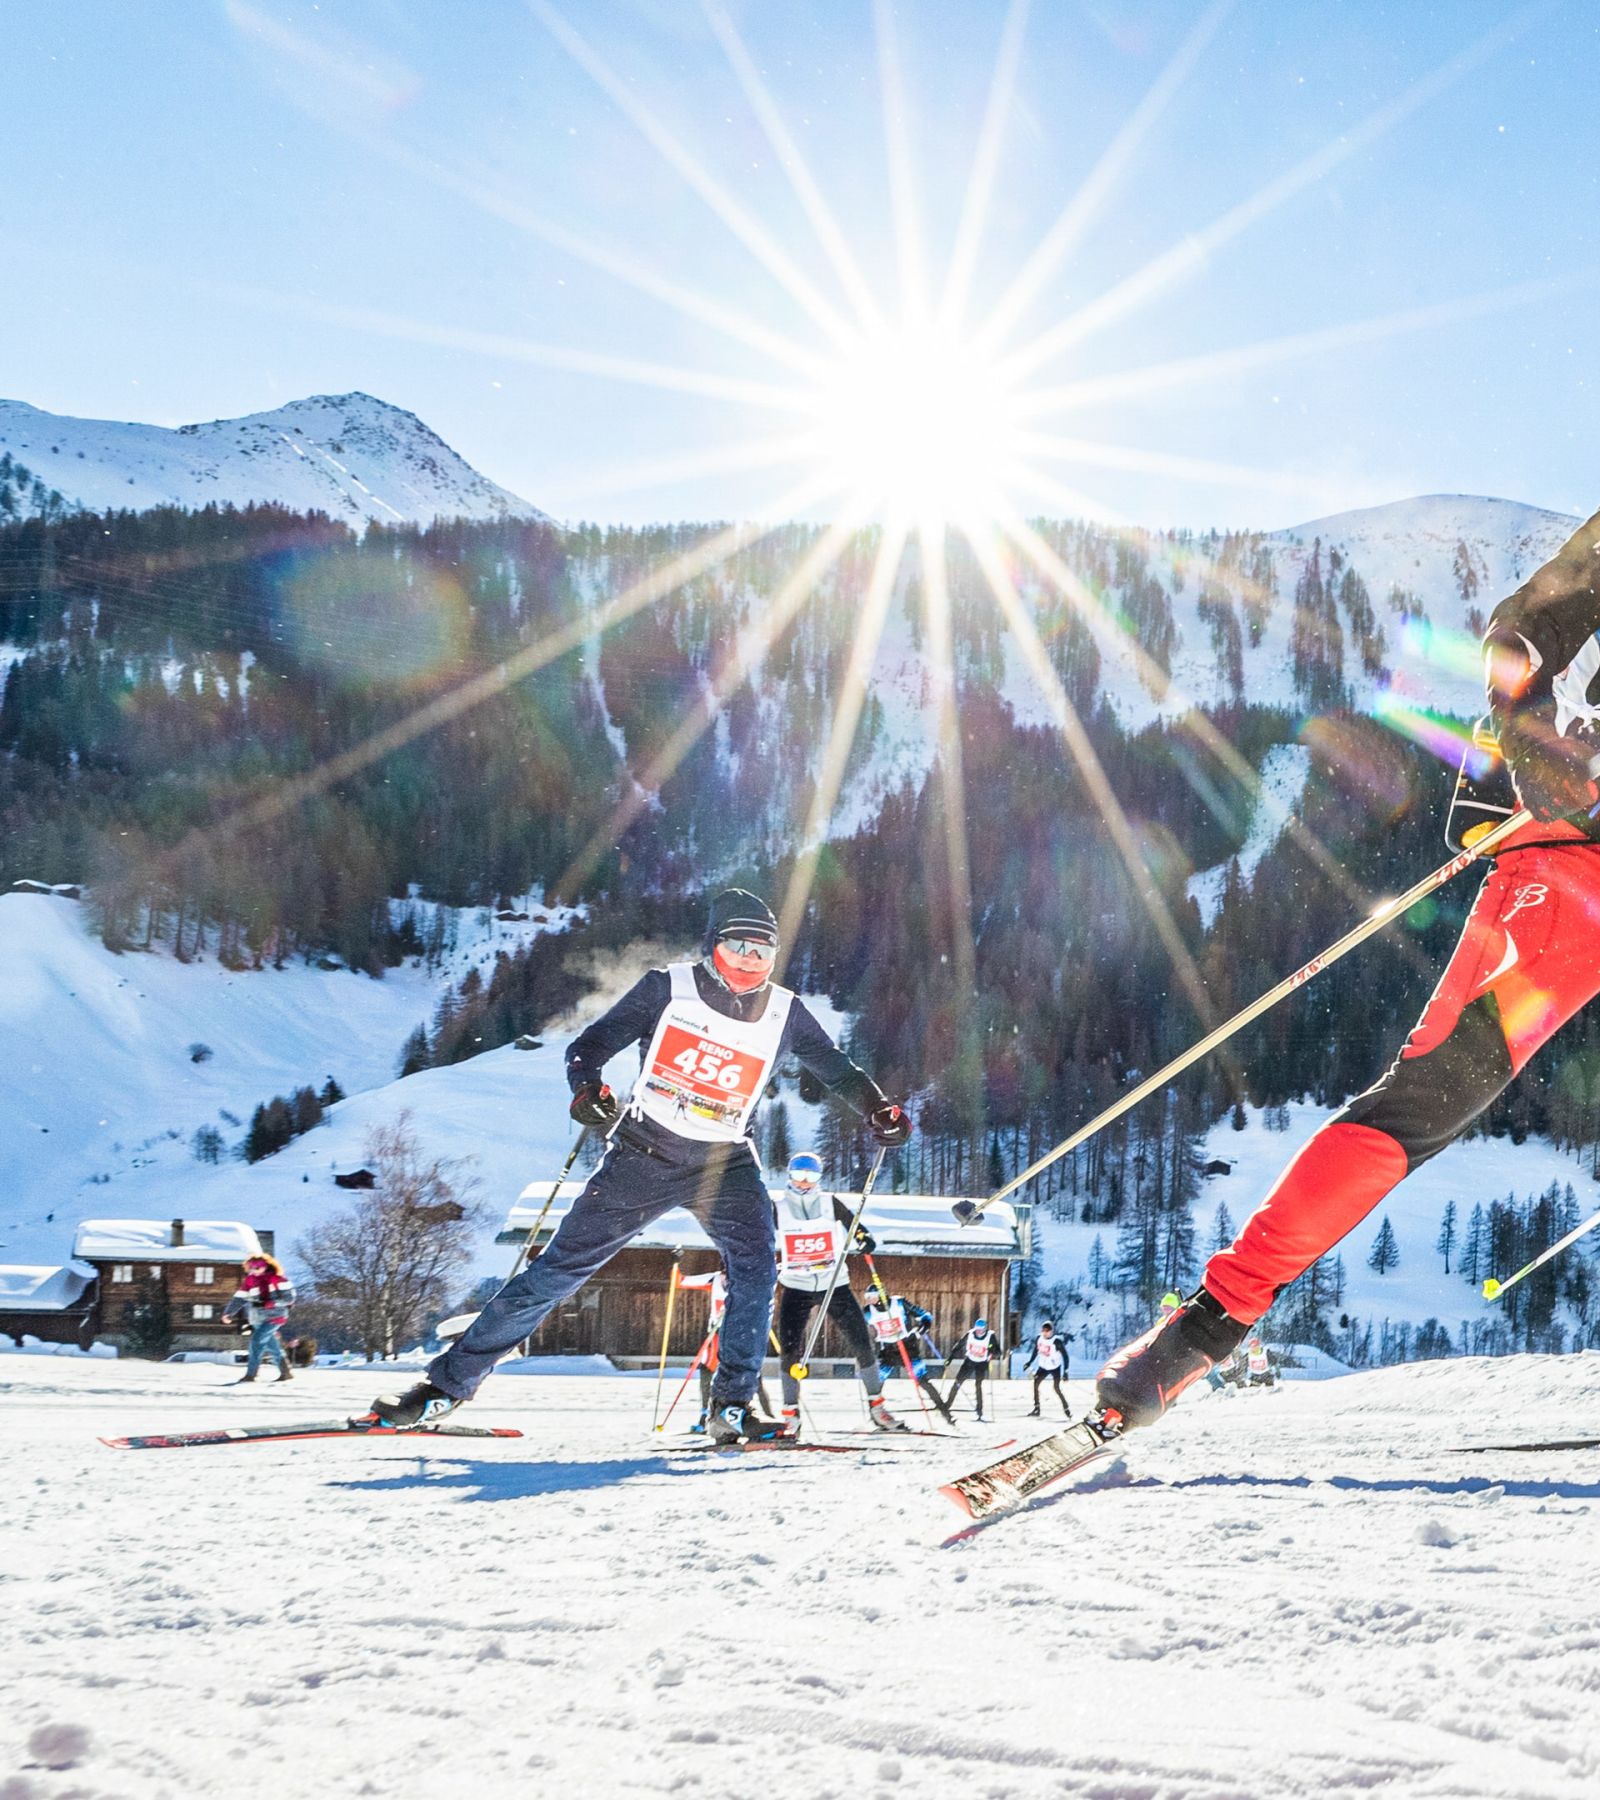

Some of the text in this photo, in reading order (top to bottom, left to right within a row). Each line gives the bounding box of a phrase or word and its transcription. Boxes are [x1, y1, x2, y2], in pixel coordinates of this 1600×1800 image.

[697, 1040, 735, 1060] RENO
[673, 1047, 743, 1090] 456
[794, 1236, 827, 1254] 556
